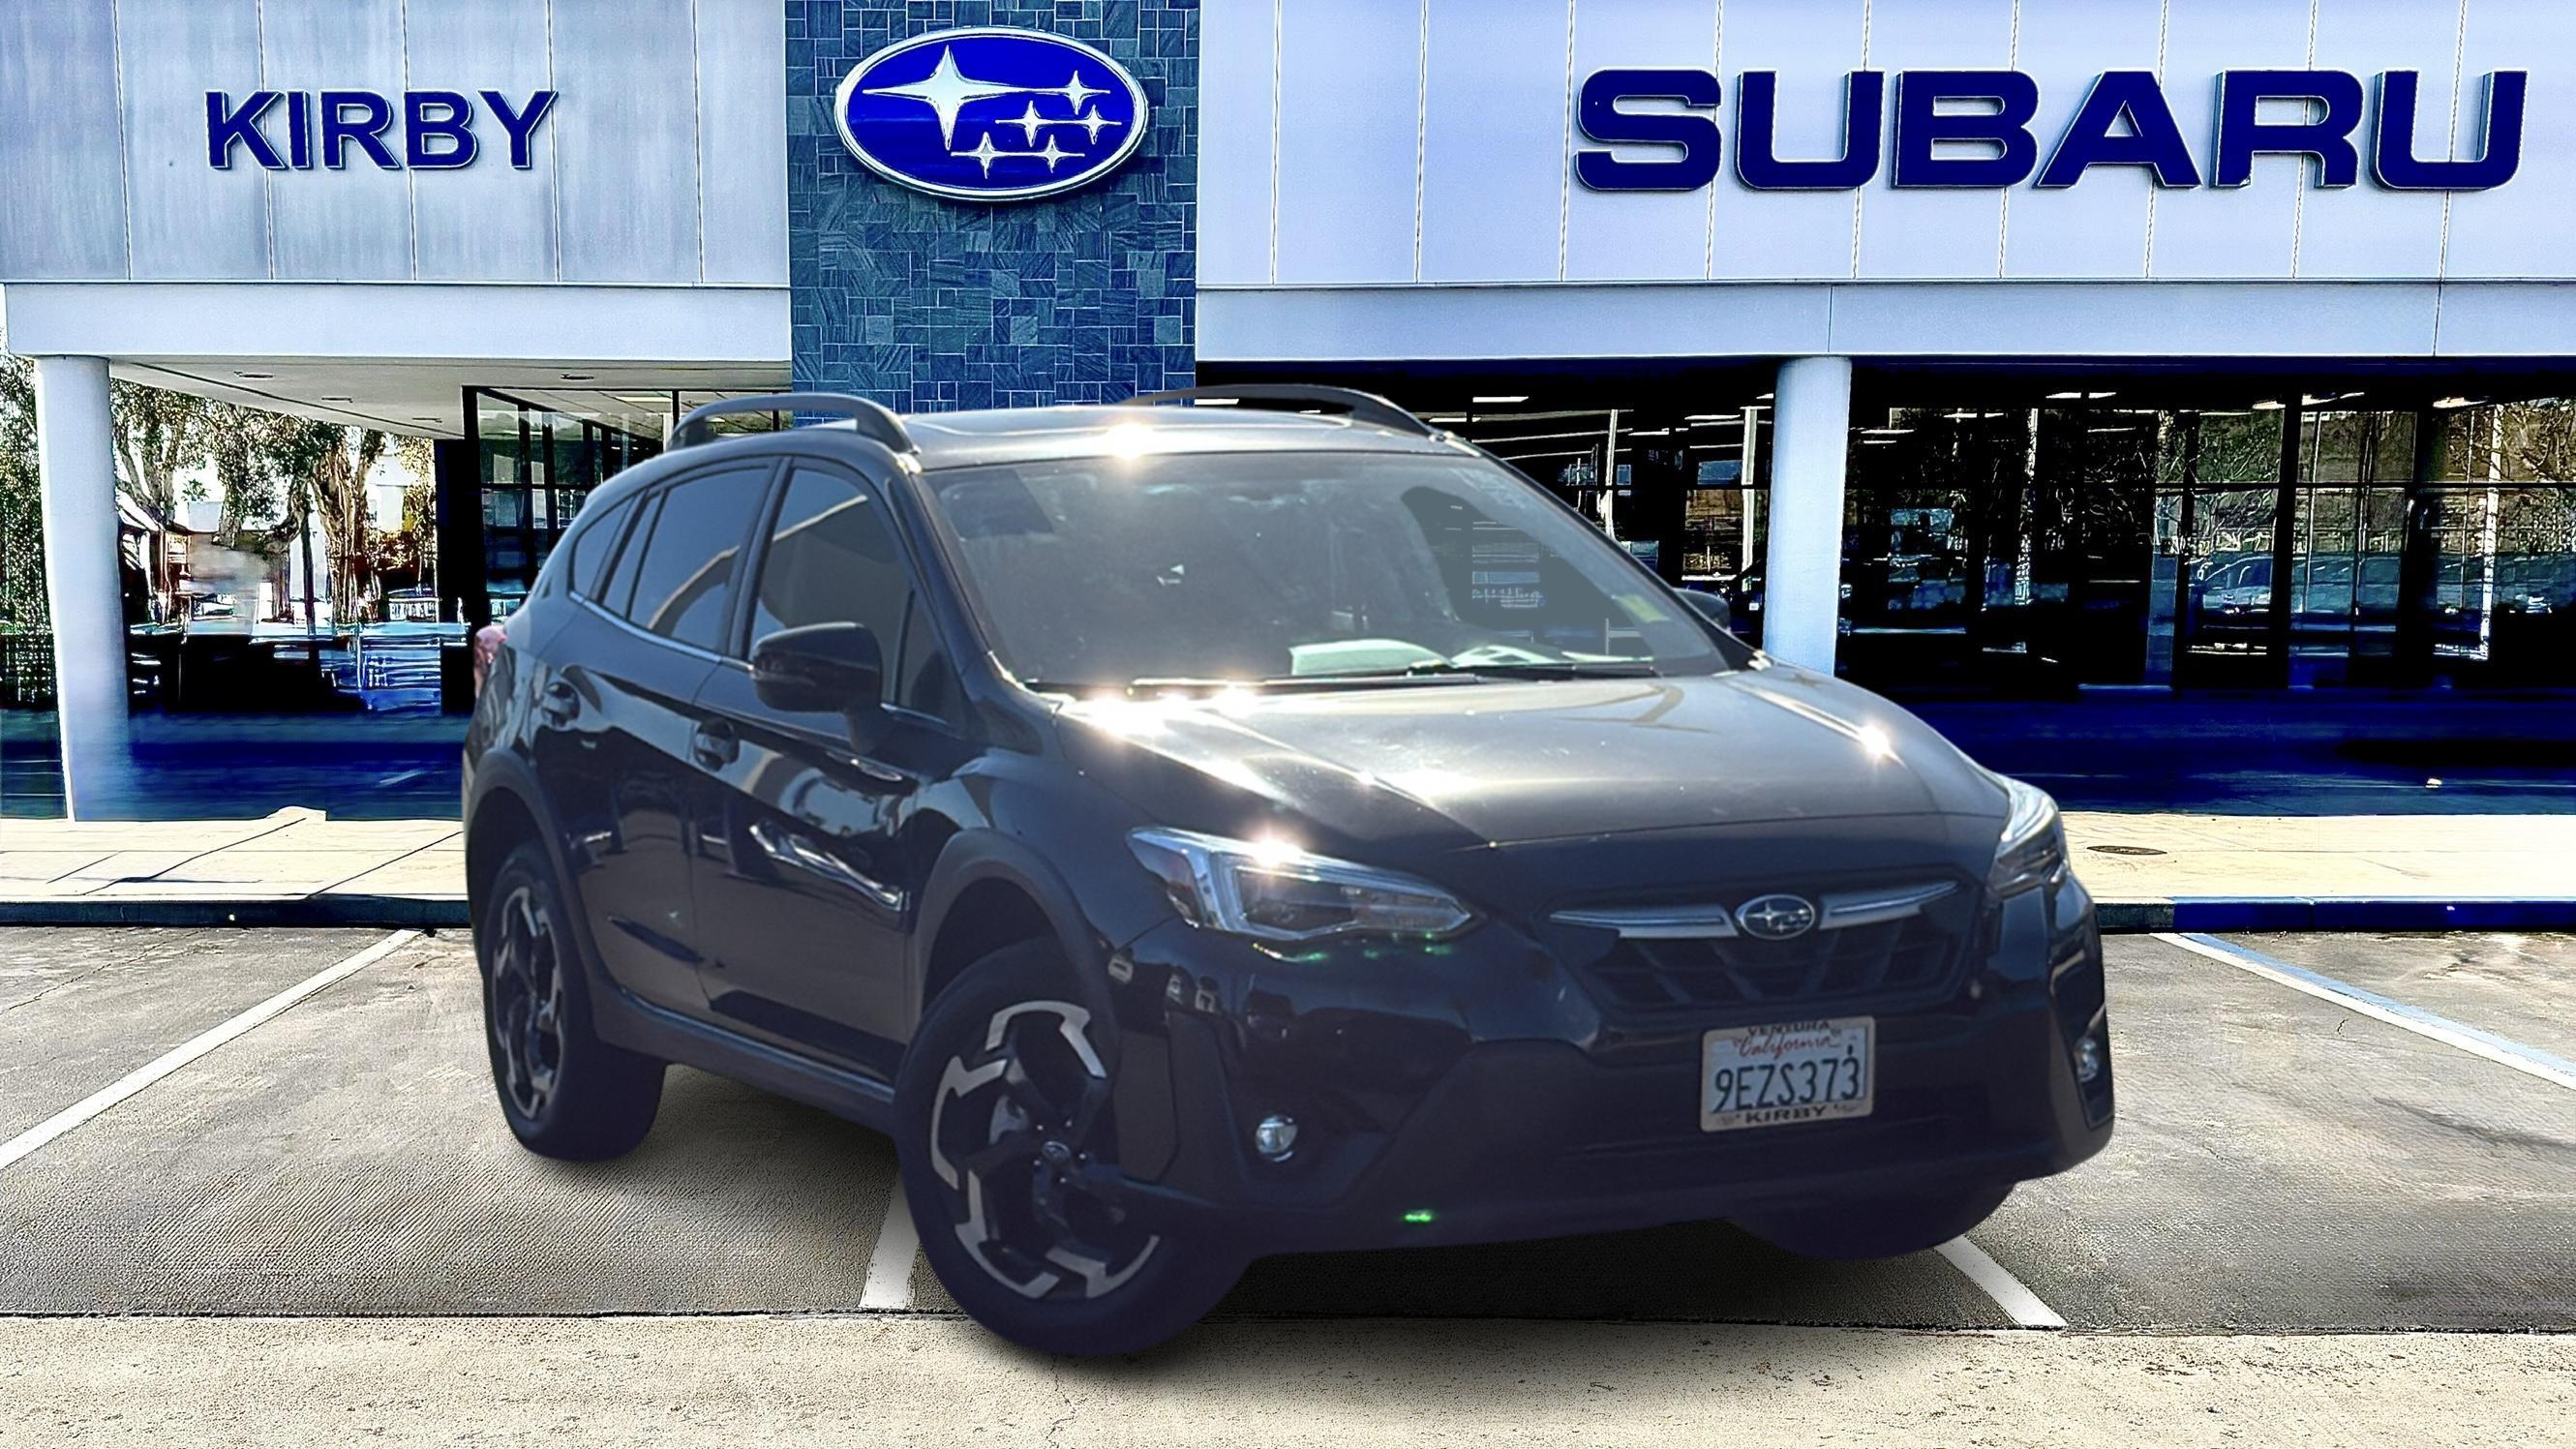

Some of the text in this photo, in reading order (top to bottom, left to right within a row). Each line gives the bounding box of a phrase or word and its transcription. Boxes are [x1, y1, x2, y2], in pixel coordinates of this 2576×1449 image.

[205, 90, 559, 169] KIRBY
[1575, 69, 2528, 191] SUBARU
[1734, 1032, 1839, 1060] California
[1712, 1057, 1860, 1113] 9EZS373
[1745, 1105, 1827, 1124] KIRBY
